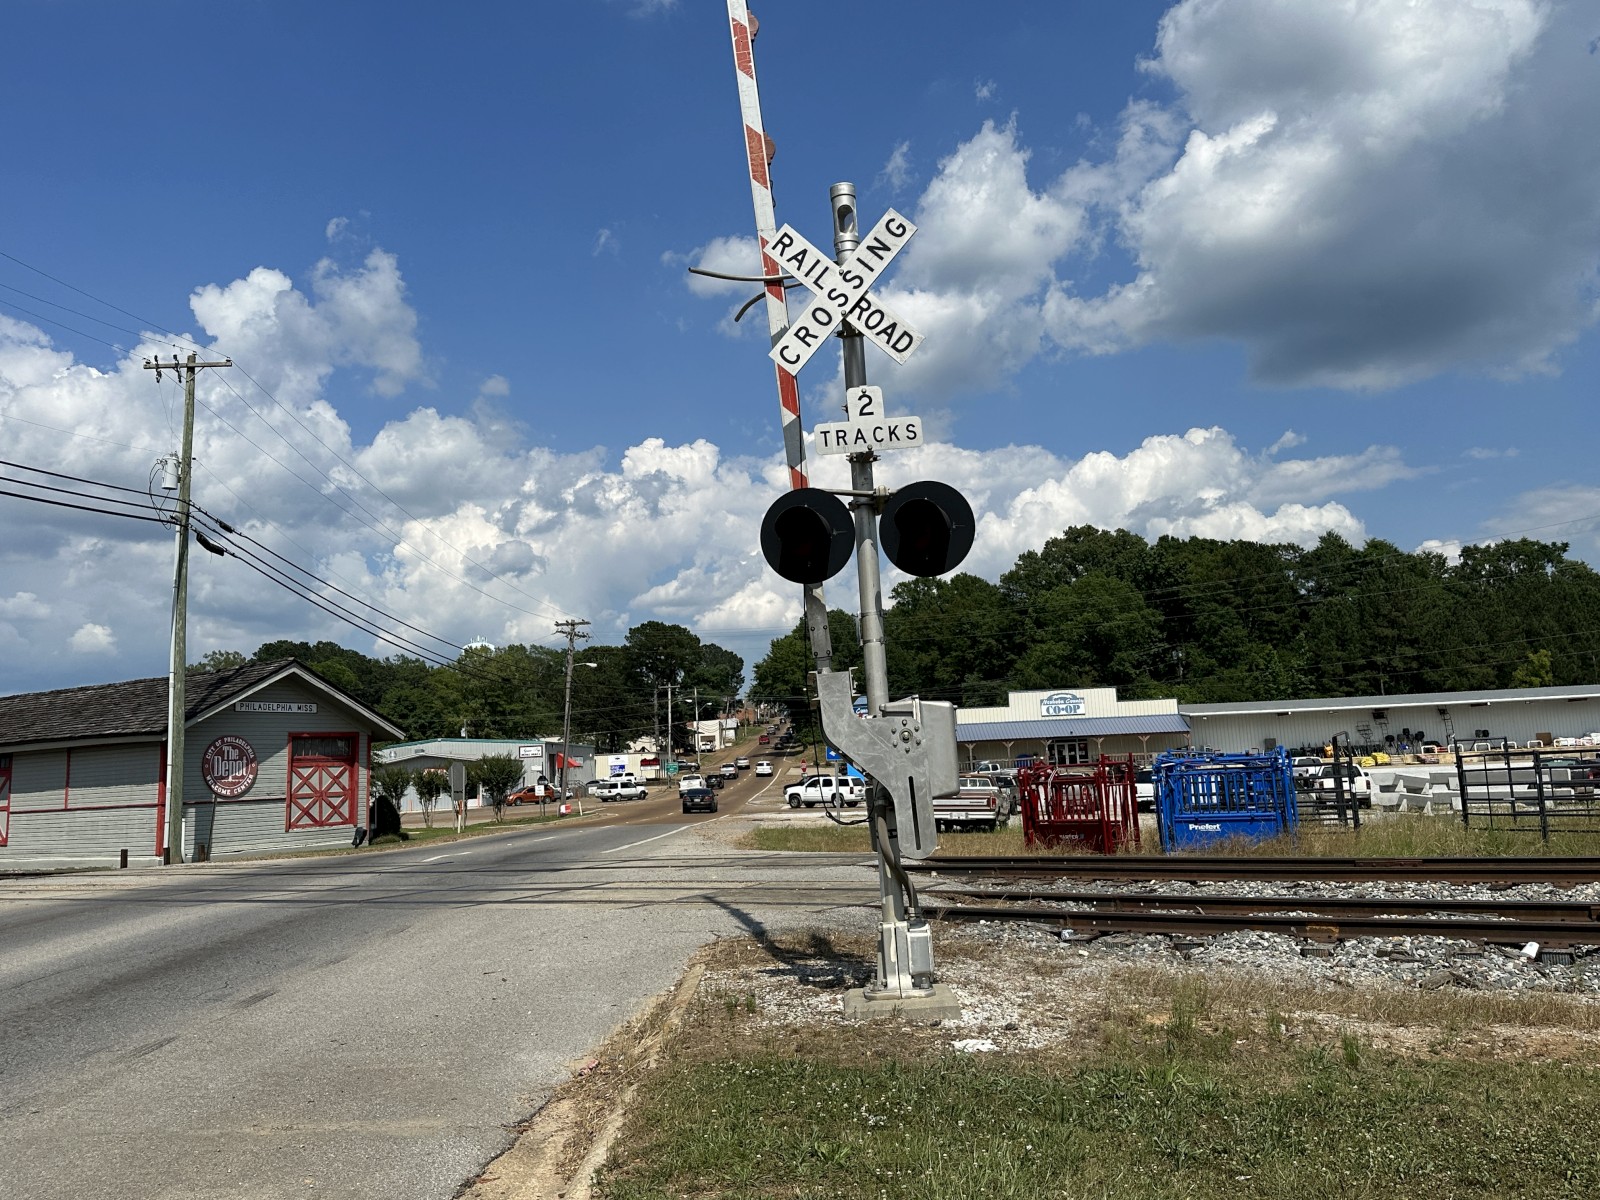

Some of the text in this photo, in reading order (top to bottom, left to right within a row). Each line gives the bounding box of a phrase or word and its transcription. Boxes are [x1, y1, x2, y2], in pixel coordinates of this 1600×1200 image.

[771, 231, 914, 353] RAIL ROAD
[779, 217, 907, 365] CROSSING
[857, 393, 875, 416] 2
[820, 423, 917, 447] TRACKS
[240, 702, 293, 712] PHILADELPHIA
[205, 737, 255, 759] CITY OF PHILADELPHIA
[222, 745, 239, 760] The
[213, 755, 247, 781] Depot
[205, 774, 254, 795] WELCOME CENTER
